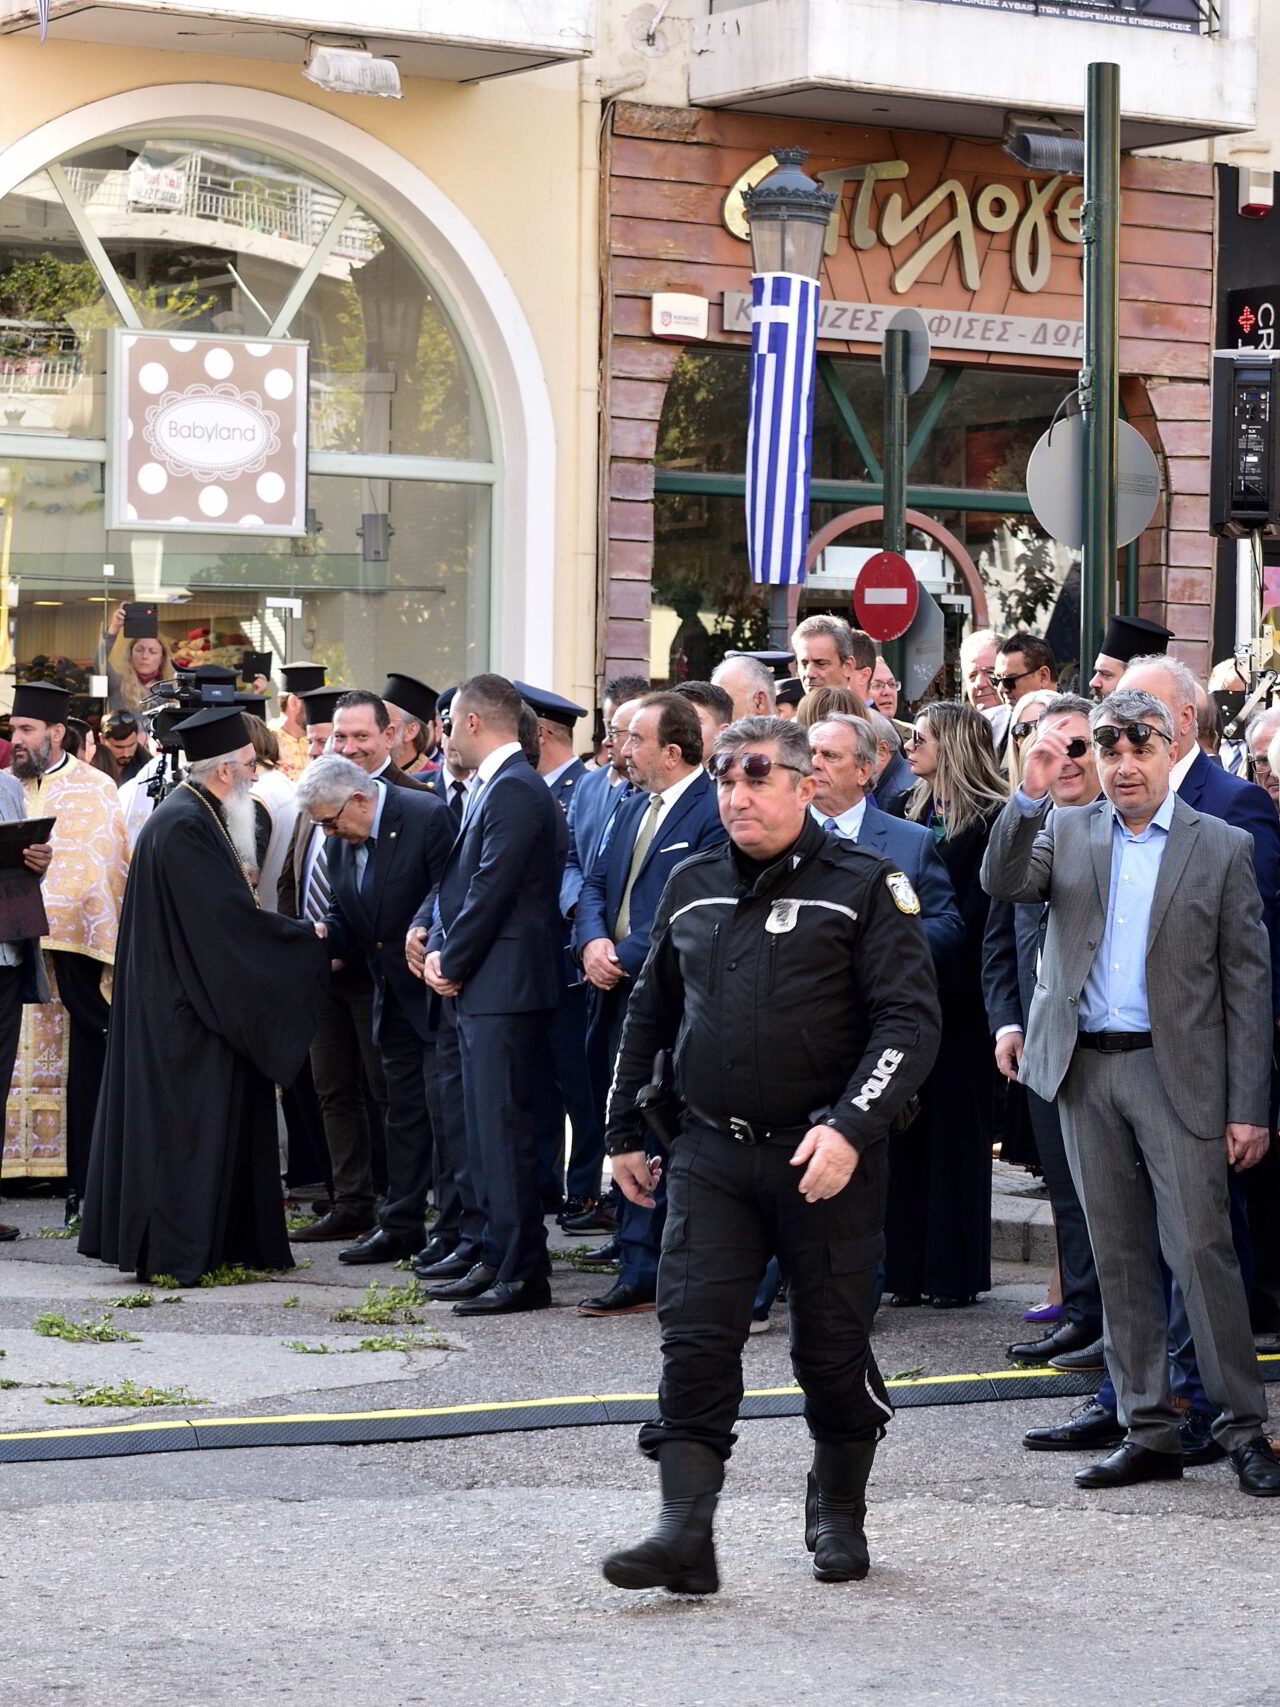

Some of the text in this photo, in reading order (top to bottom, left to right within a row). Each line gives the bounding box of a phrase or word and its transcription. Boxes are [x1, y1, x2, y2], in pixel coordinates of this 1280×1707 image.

[928, 315, 1014, 342] ΦΙΣΕΣ
[169, 420, 256, 443] Babyland
[850, 1047, 905, 1112] POLICE
